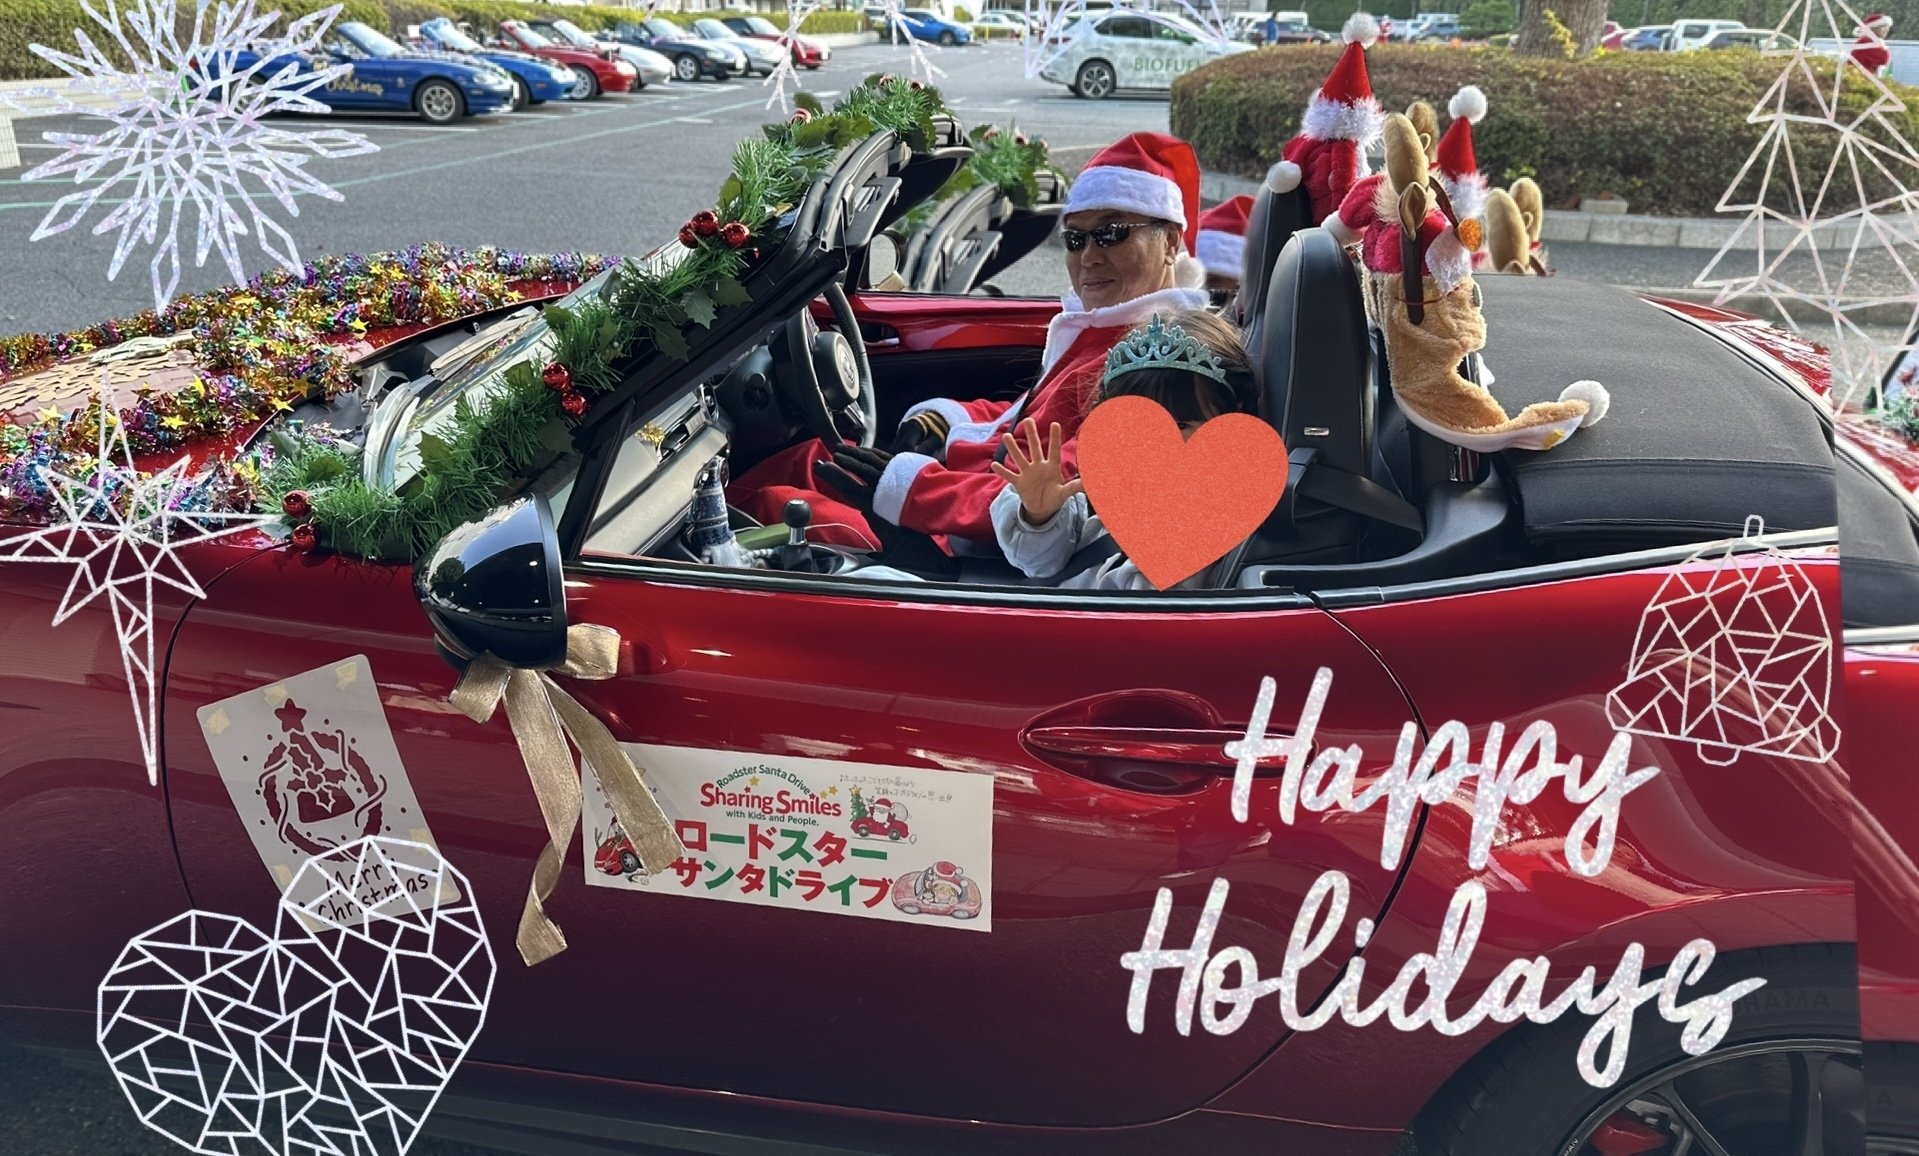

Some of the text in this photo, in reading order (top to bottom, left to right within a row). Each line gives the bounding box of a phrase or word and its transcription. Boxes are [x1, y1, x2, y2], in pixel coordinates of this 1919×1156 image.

[716, 764, 811, 795] Roadster Santa Drive
[700, 782, 774, 815] Sharing
[775, 790, 842, 817] Smiles
[726, 810, 819, 827] with Kids and People.
[675, 819, 888, 867] ロードスター
[670, 856, 894, 909] サンタドライブ
